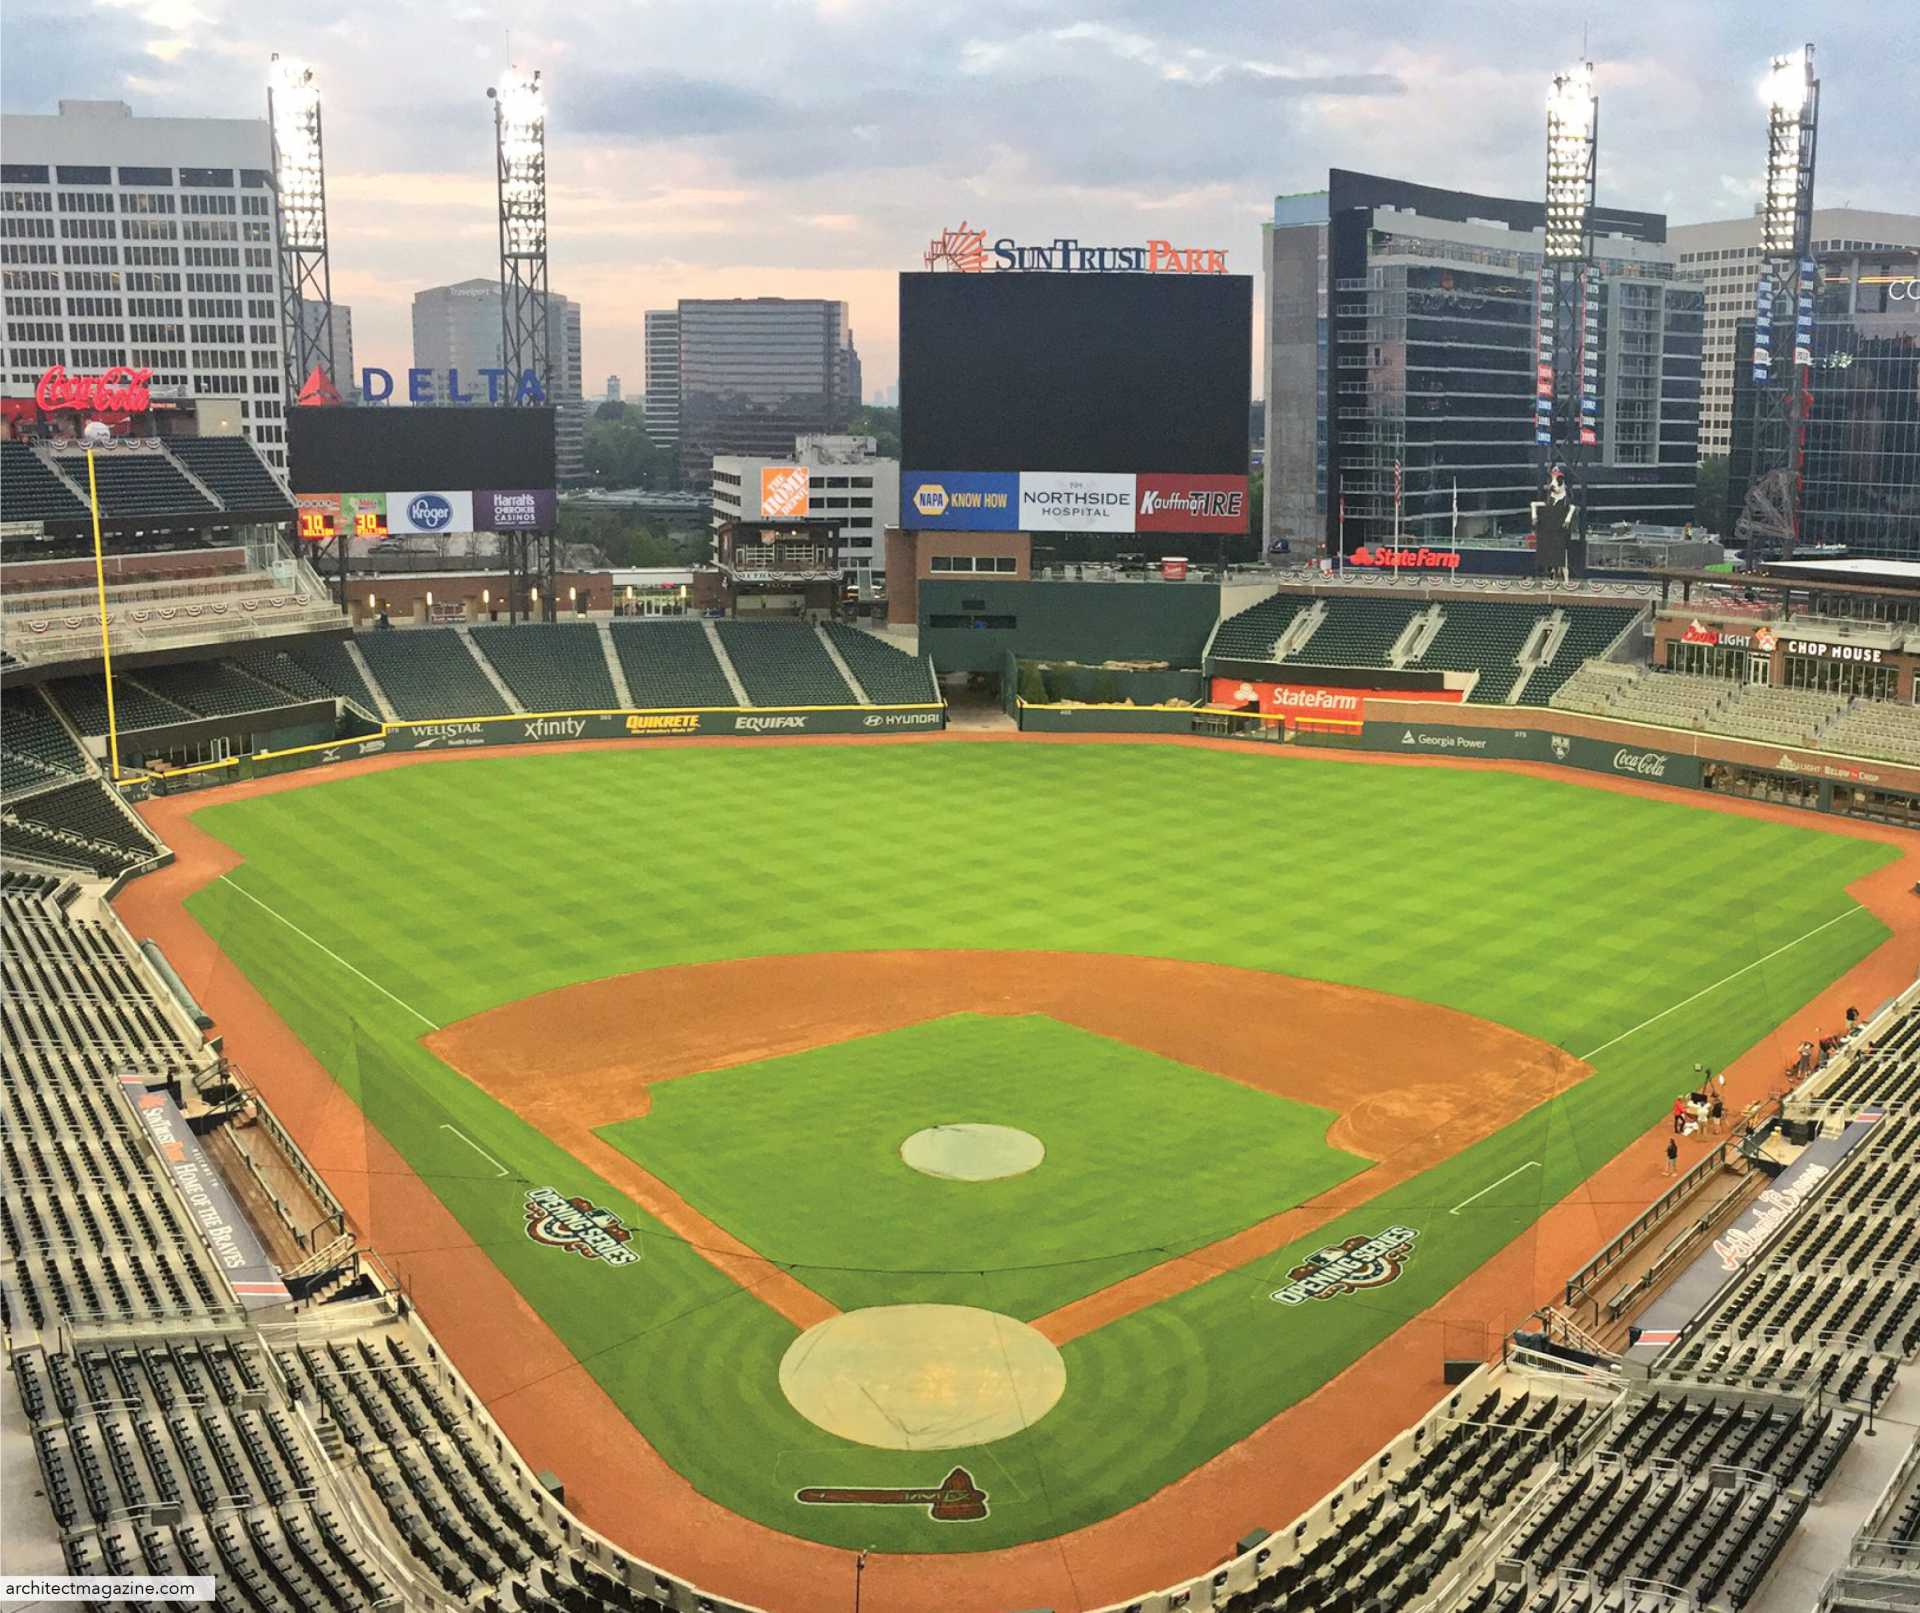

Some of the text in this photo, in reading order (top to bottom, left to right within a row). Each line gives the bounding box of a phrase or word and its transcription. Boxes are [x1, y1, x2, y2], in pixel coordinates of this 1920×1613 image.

[362, 368, 545, 402] DELTA
[919, 493, 1008, 508] NAPA KNOW HOW
[1024, 491, 1130, 506] NORTHSIDE
[1140, 490, 1243, 516] Kauffman TIRE
[412, 500, 449, 527] Kroger
[1042, 508, 1110, 517] HOSPITAL
[355, 514, 377, 529] 30
[1718, 633, 1751, 647] LIGHT
[1789, 640, 1881, 663] CHOP HOUSE
[626, 715, 700, 729] QUIKRETE
[735, 717, 808, 732] EQUIFAX
[885, 714, 939, 725] HYUNDAI
[524, 717, 586, 740] xfinity
[1418, 734, 1487, 749] Georgia Power
[174, 1162, 246, 1268] HOME OF THE BRAVES
[529, 1188, 638, 1265] OPENING SERIES
[1274, 1227, 1416, 1304] OPENING SERIES
